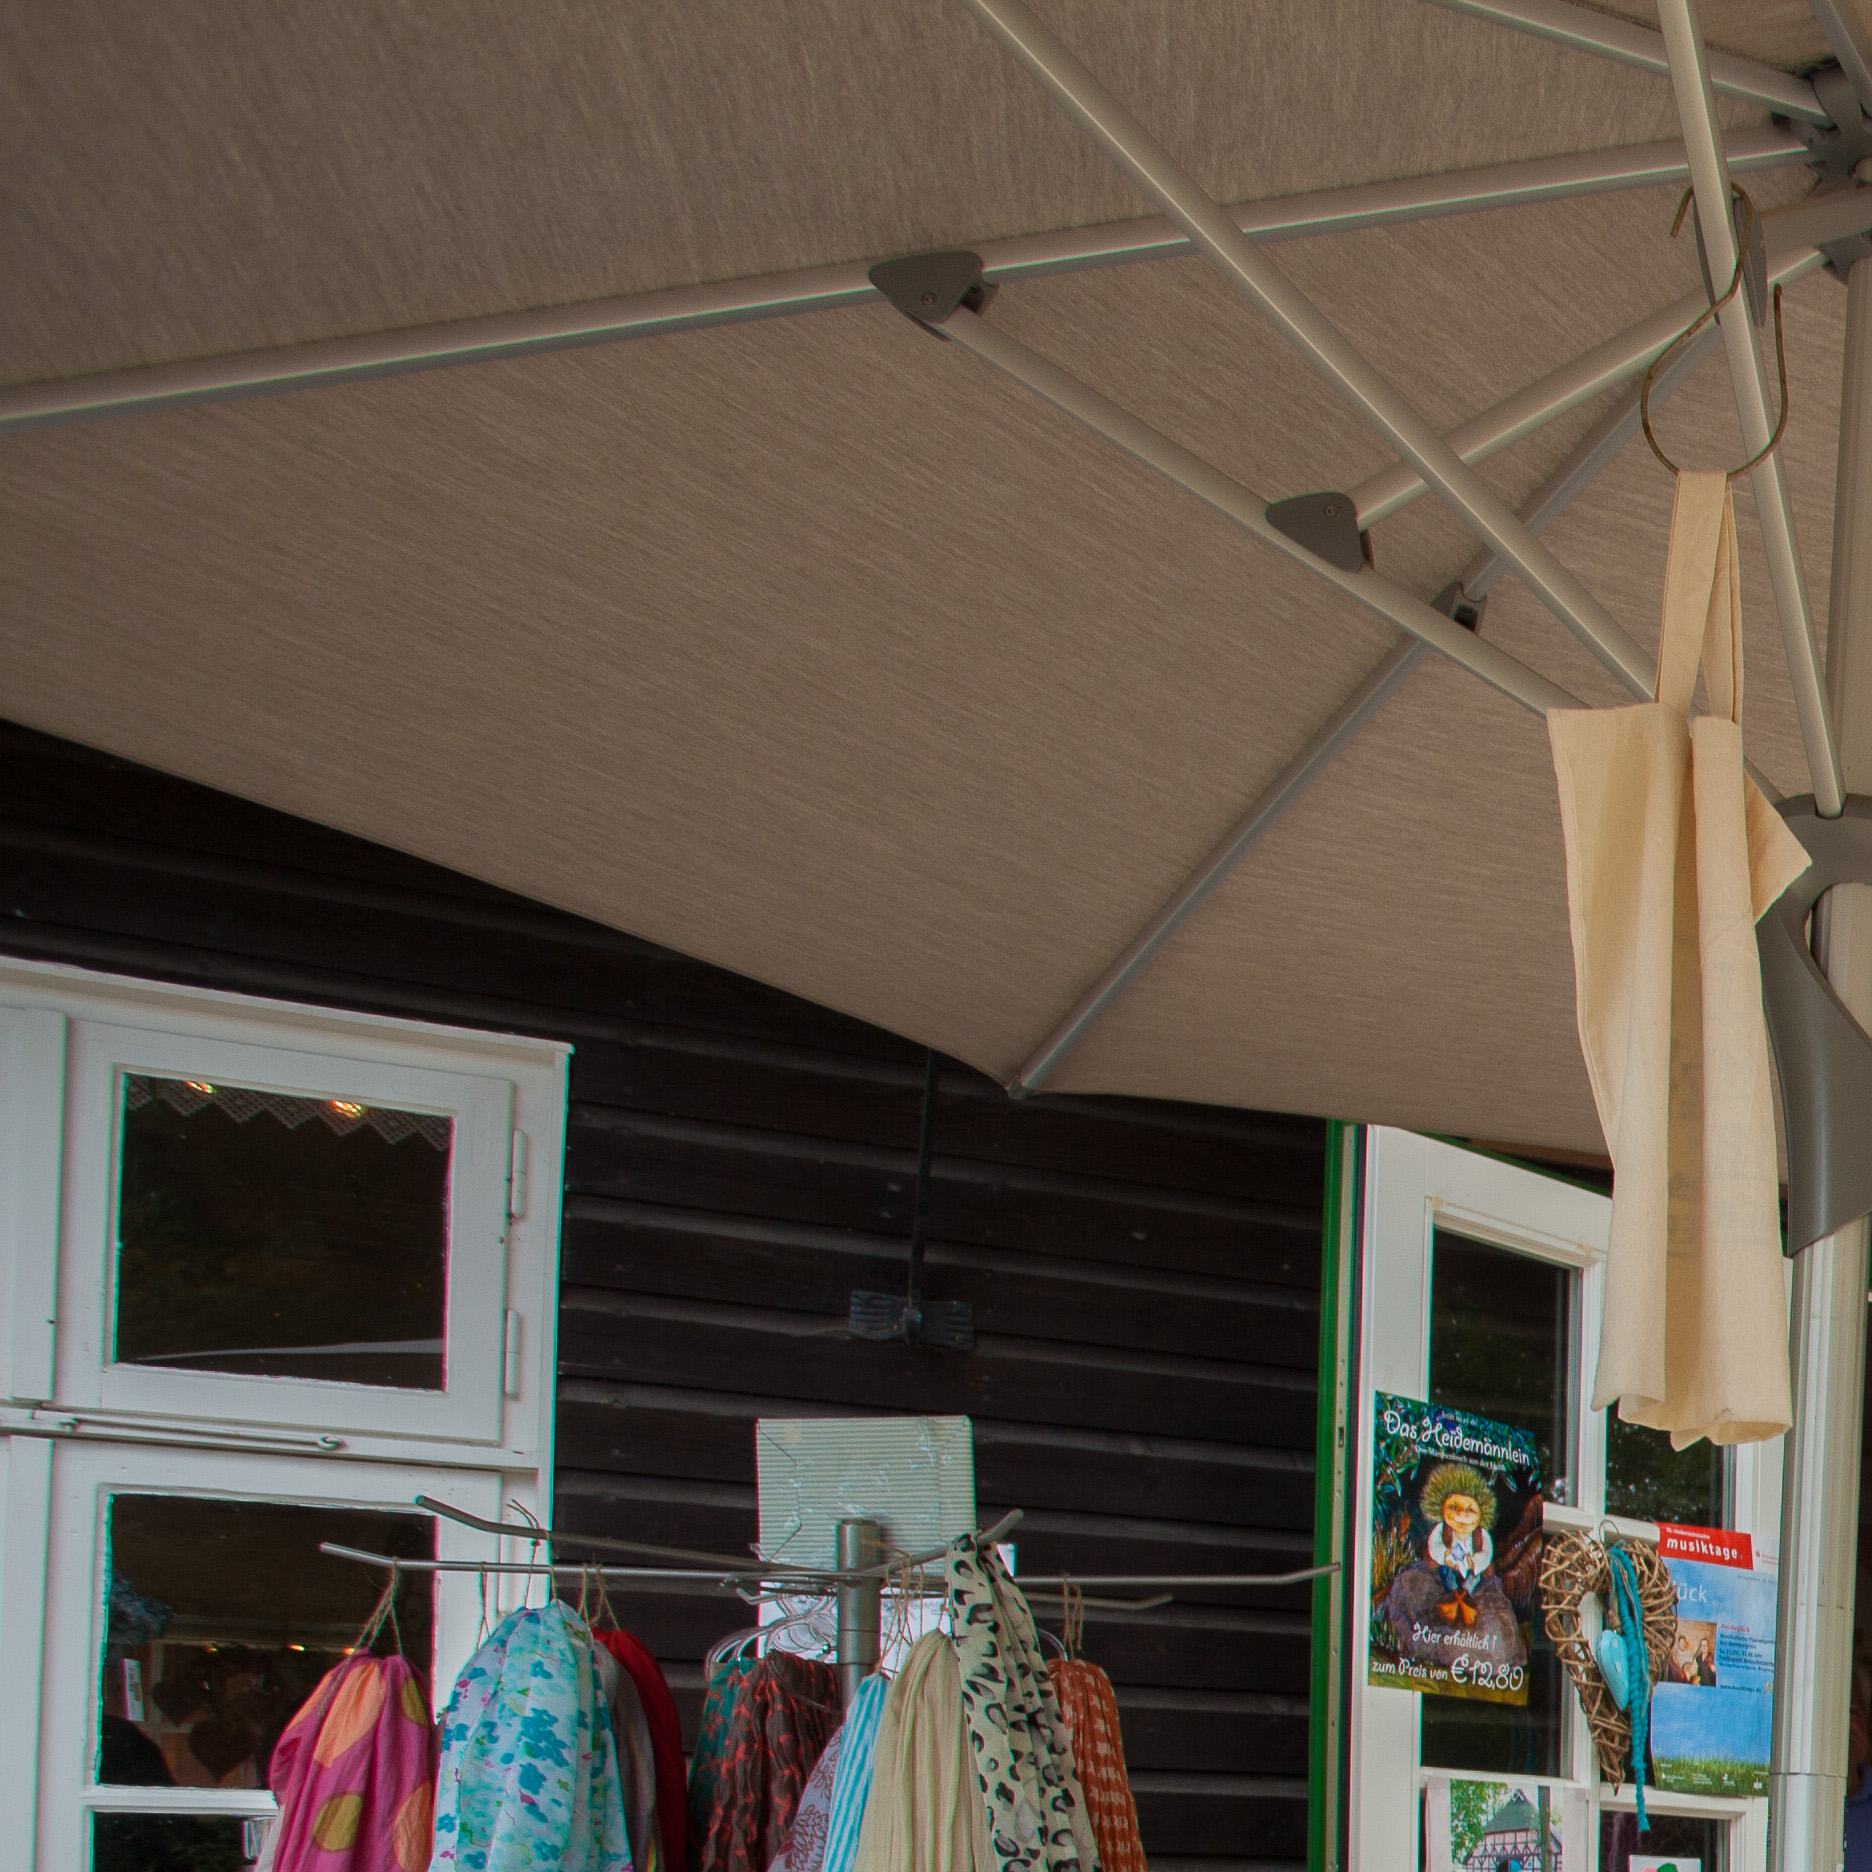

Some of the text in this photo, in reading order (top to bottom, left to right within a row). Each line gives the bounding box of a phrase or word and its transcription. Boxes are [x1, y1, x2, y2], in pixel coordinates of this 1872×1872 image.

[1384, 1410, 1418, 1439] Das
[1420, 1416, 1530, 1466] Heidemännlein
[1666, 1538, 1738, 1560] musiktage
[1674, 1580, 1707, 1603] ück
[1412, 1621, 1441, 1644] Hier
[1443, 1629, 1491, 1650] erhältlich
[1372, 1661, 1396, 1674] zum
[1398, 1656, 1428, 1678] Preis
[1429, 1668, 1448, 1681] von
